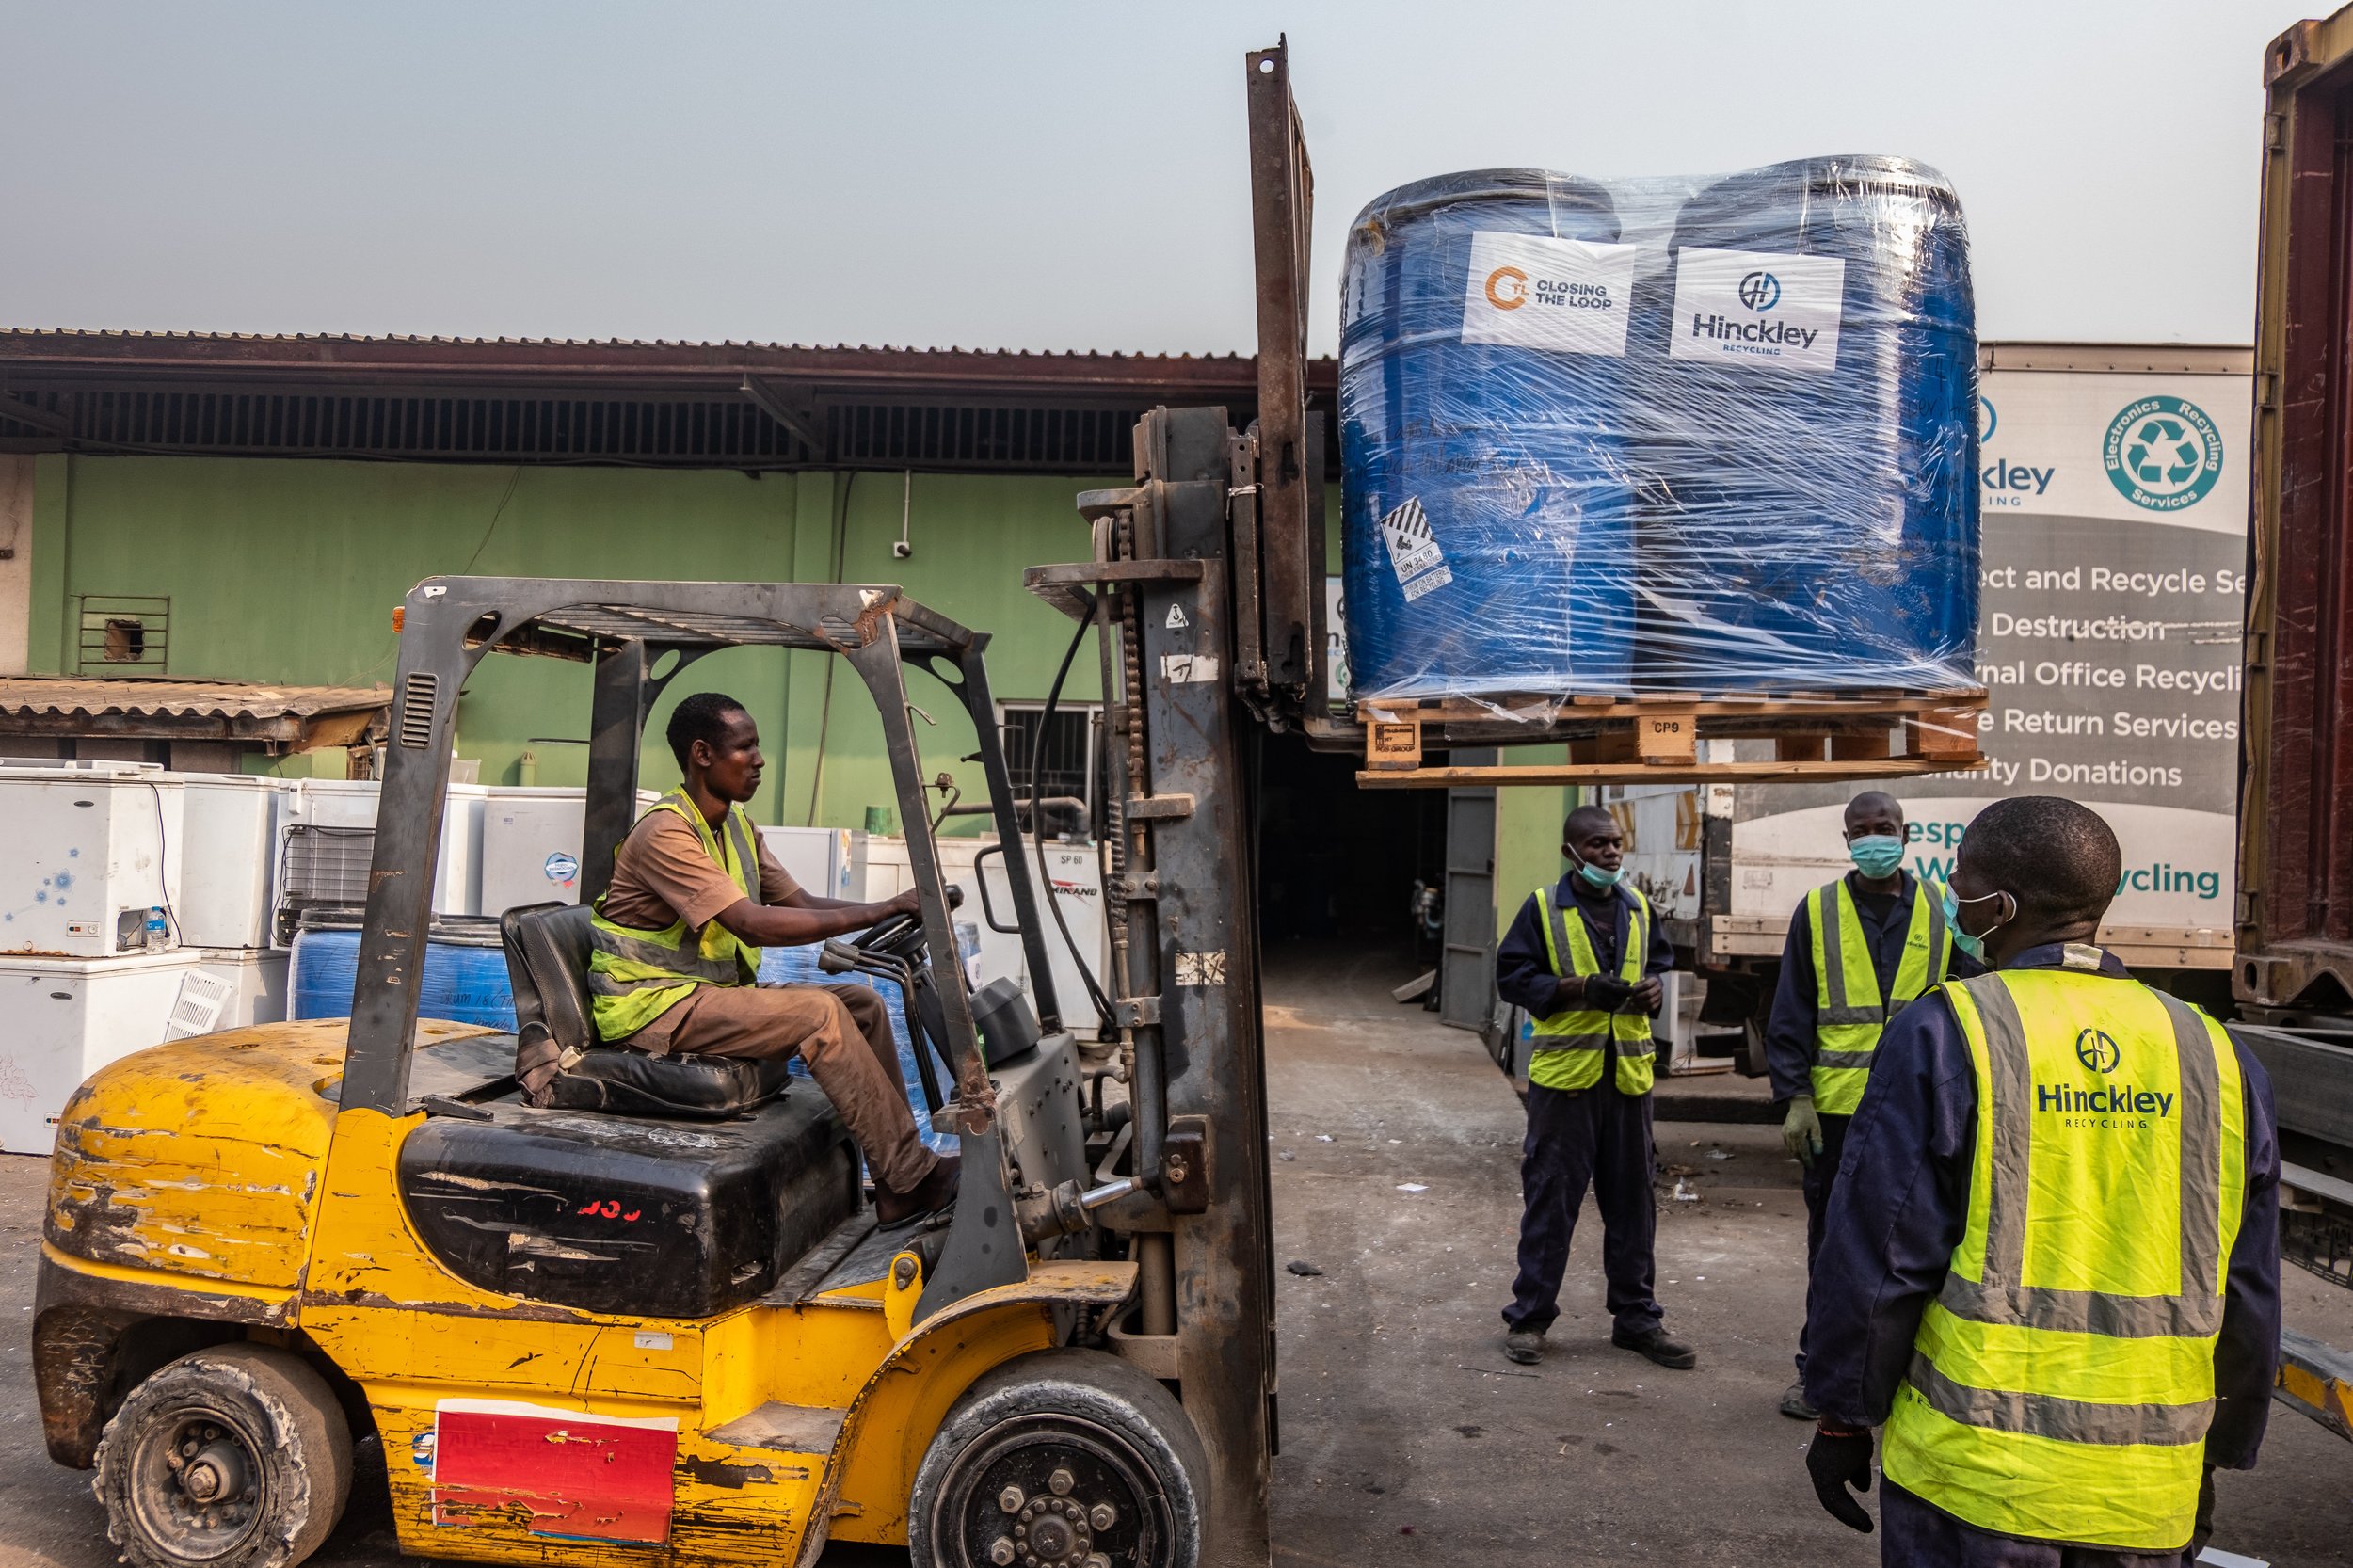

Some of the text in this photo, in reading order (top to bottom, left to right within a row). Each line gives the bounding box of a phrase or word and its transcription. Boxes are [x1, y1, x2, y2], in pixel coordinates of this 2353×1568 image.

[1536, 280, 1607, 297] CLOSING
[1535, 293, 1612, 310] THE LOOP
[1692, 313, 1818, 349] Hinckley
[1723, 344, 1781, 356] RECYCLING
[2105, 400, 2221, 472] Electronics Recycling
[2132, 488, 2198, 508] Services
[1401, 550, 1433, 572] UN 3480
[1417, 577, 1426, 586] ION
[1425, 567, 1449, 582] BATTERIES
[2025, 567, 2081, 590] and
[2091, 568, 2206, 596] Recycle
[1410, 577, 1446, 599] FOR RECYCLING
[1992, 612, 2165, 640] Destruction
[2035, 662, 2126, 687] Office
[1654, 721, 1679, 733] CP9
[2005, 709, 2104, 735] Return
[2113, 712, 2239, 740] Services
[2029, 758, 2183, 787] Donations
[1061, 855, 1083, 865] SP 60
[2037, 1083, 2174, 1118] Hinckley
[2065, 1118, 2148, 1129] RECYCLING
